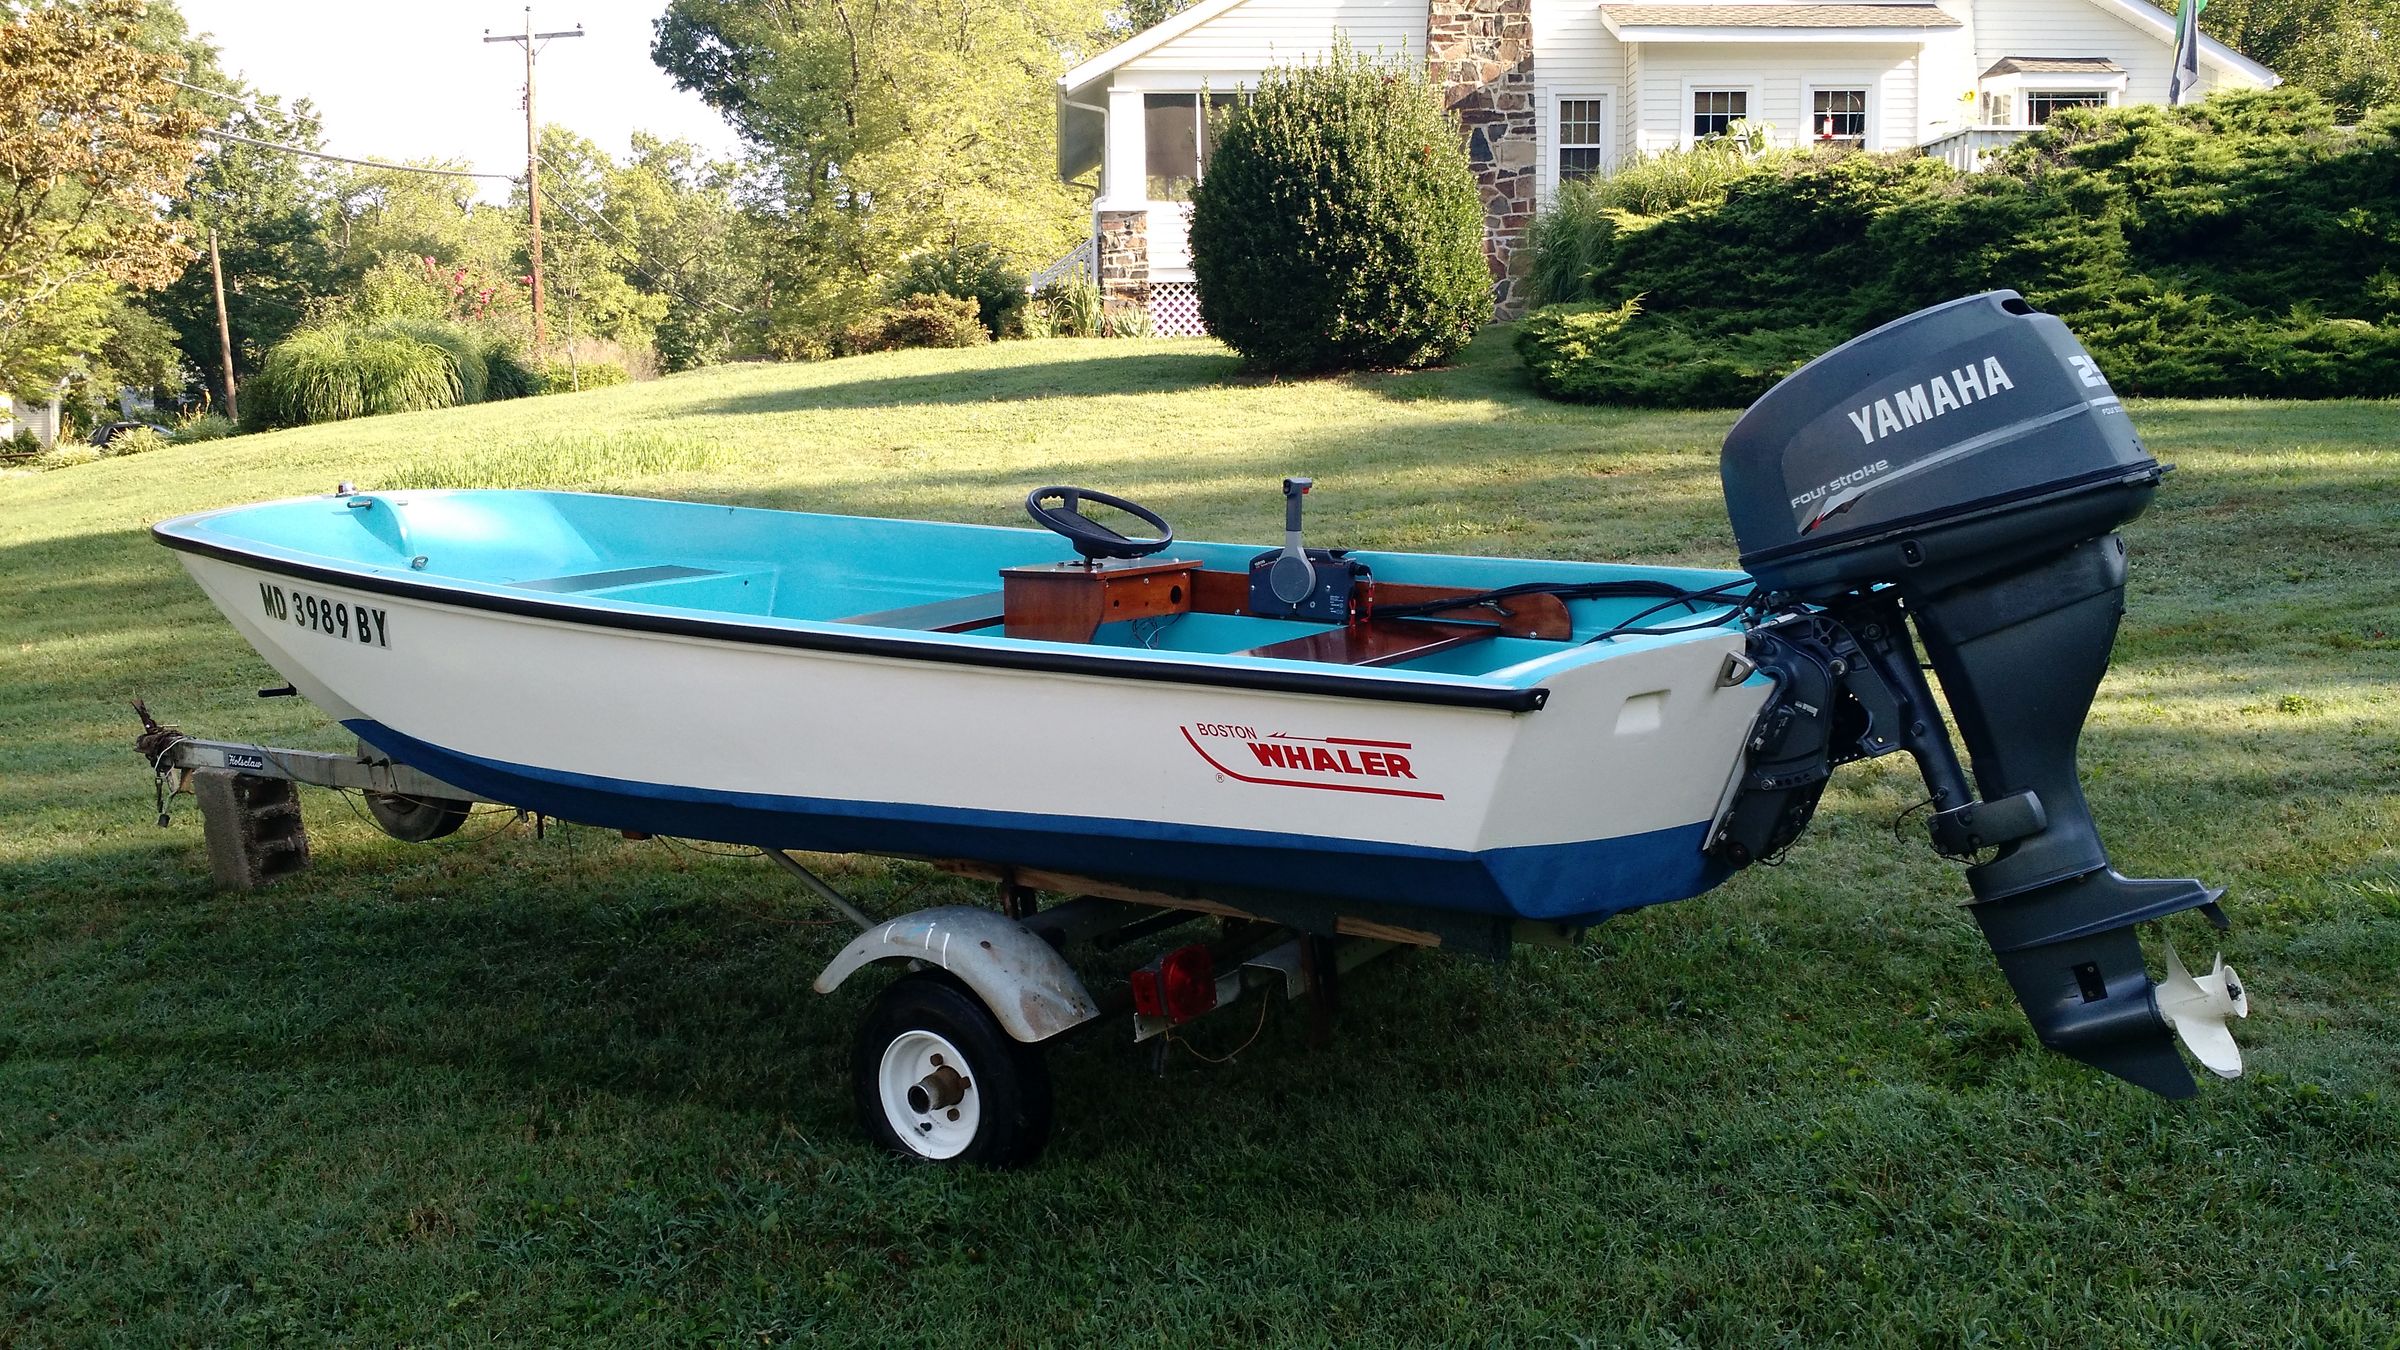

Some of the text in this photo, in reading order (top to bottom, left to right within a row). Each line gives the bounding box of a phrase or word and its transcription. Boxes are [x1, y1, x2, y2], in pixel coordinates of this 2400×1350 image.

[1847, 355, 2015, 445] YAMAHA
[259, 582, 387, 647] MD 3989 BY
[1196, 722, 1258, 740] BOSTON
[228, 754, 263, 768] Holsclaw
[1246, 741, 1418, 780] WHALER
